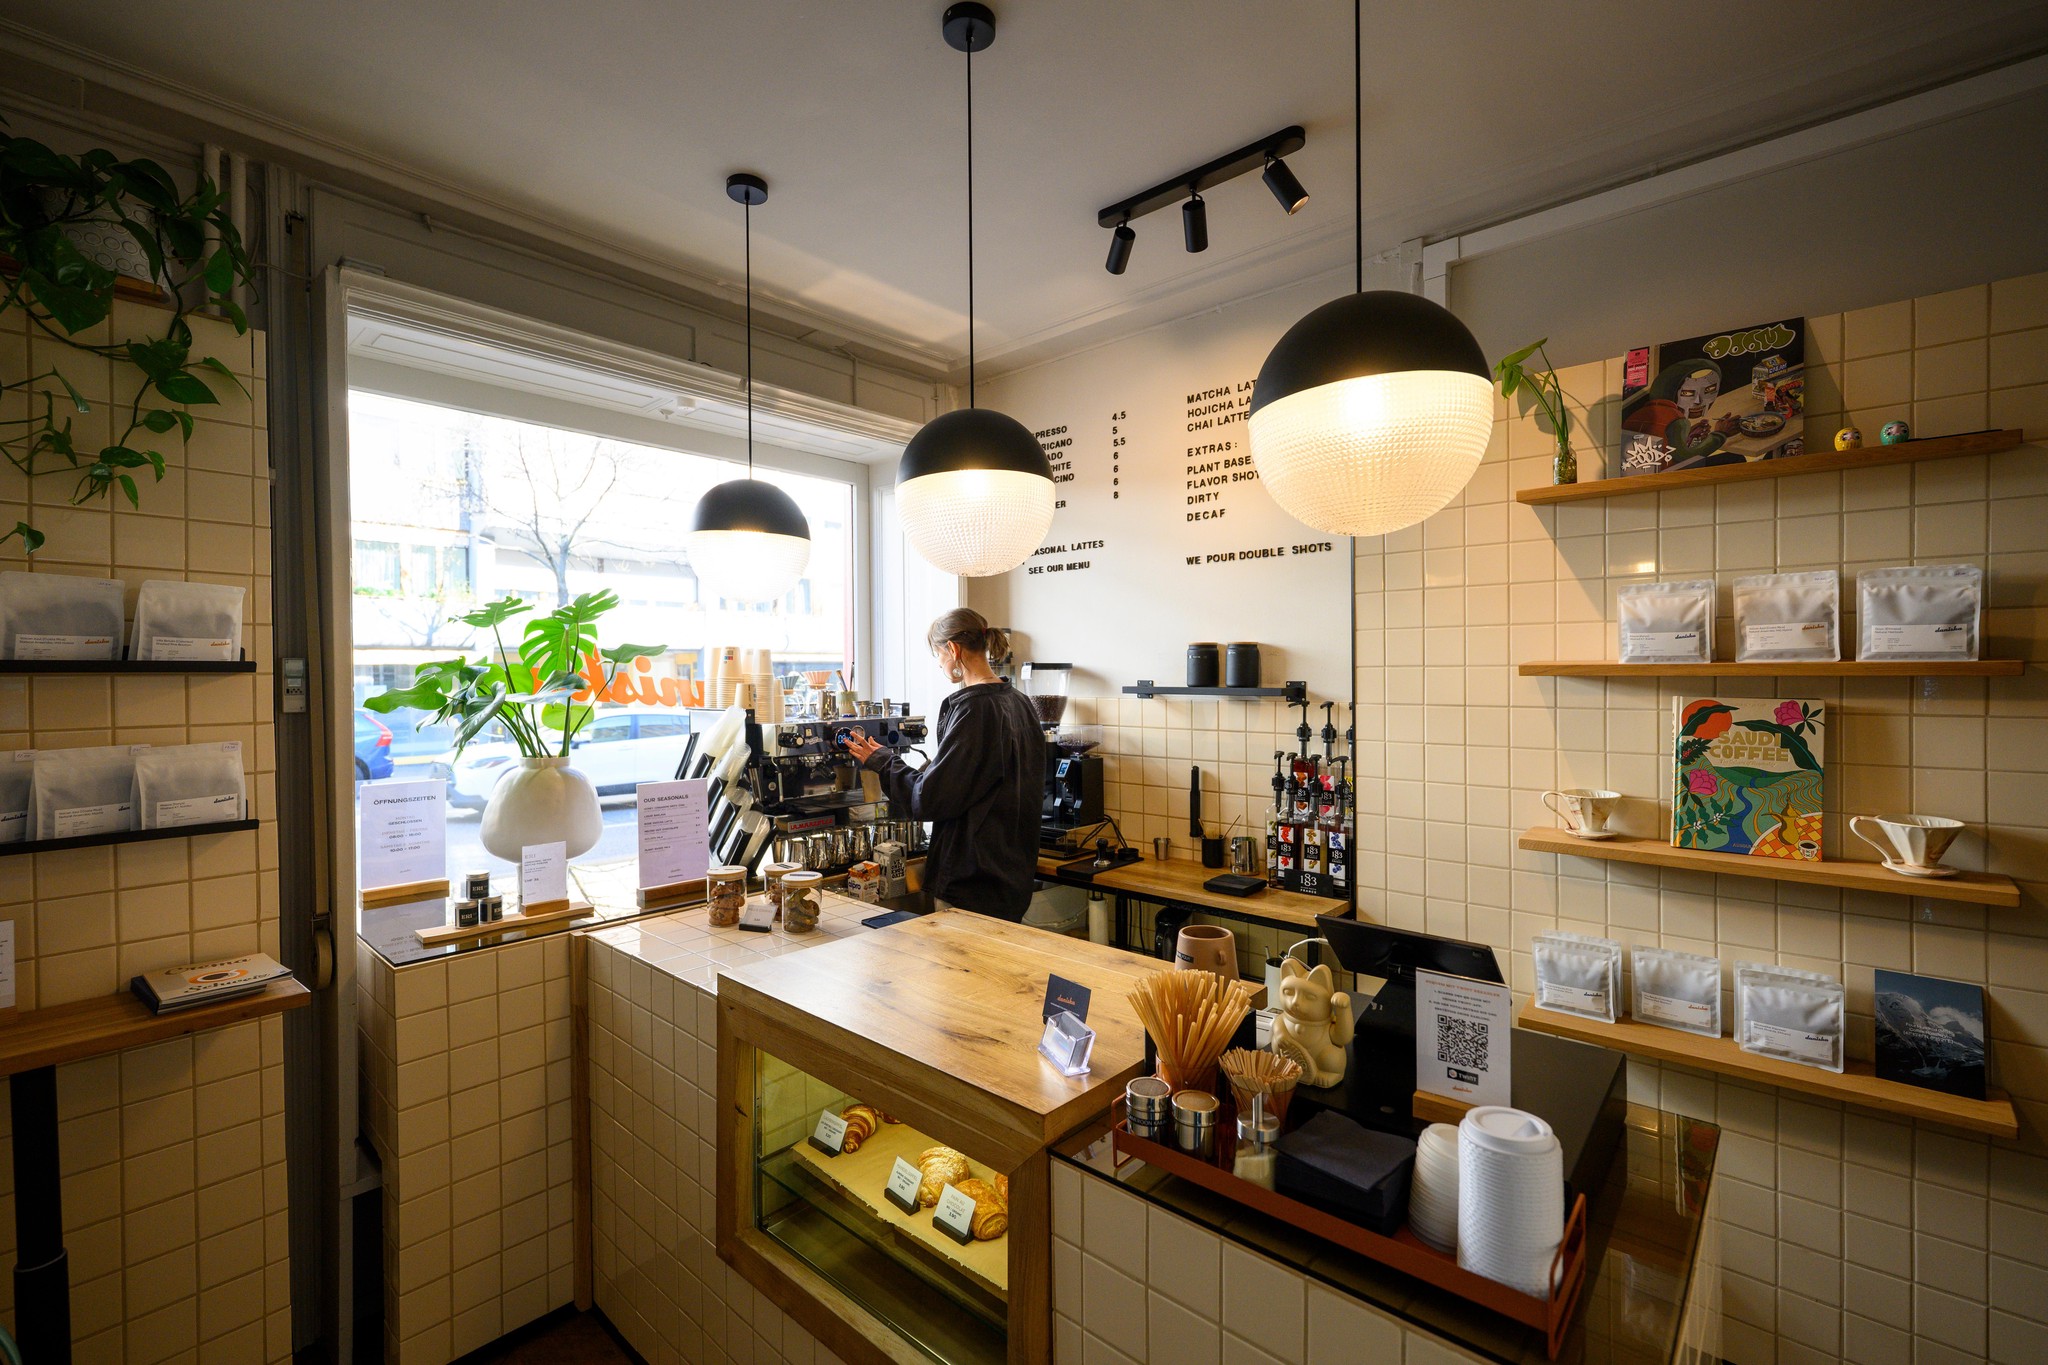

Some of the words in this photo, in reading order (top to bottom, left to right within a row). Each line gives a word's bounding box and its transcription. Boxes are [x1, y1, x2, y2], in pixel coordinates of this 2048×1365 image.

[1187, 386, 1231, 404] MATCHA
[1237, 379, 1257, 392] LAT
[1187, 400, 1234, 418] HOJICHA
[1238, 396, 1251, 407] LA
[1112, 411, 1126, 421] 4.5
[1187, 419, 1213, 432] CHAI
[1217, 411, 1250, 426] LATTE
[1033, 425, 1067, 439] PRESSO
[1112, 426, 1118, 435] 5
[1042, 438, 1073, 451] RICANO
[1113, 437, 1126, 447] 5.5
[1114, 452, 1119, 460] 6
[1051, 462, 1072, 473] HITE
[1114, 465, 1119, 473] 6
[1187, 461, 1221, 475] PLANT
[1224, 455, 1254, 468] BASE
[1114, 478, 1119, 486] 6
[1187, 475, 1228, 490] FLAVOR
[1187, 492, 1219, 505] DIRTY
[1187, 508, 1226, 522] DECAF
[1071, 540, 1104, 551] LATTES
[1186, 556, 1201, 565] WE
[1206, 552, 1236, 564] POUR
[1239, 547, 1285, 560] DOUBLE
[1291, 542, 1332, 555] SHOTS
[1028, 566, 1044, 575] SEE
[1046, 564, 1064, 572] OUR
[1066, 560, 1090, 571] MENU
[1718, 730, 1782, 748] SAUDI
[1709, 745, 1789, 762] COFFEE
[374, 795, 437, 806] ÖFFNUNGSZEITEN
[657, 794, 689, 802] SEASONALS
[164, 958, 252, 976] Crema
